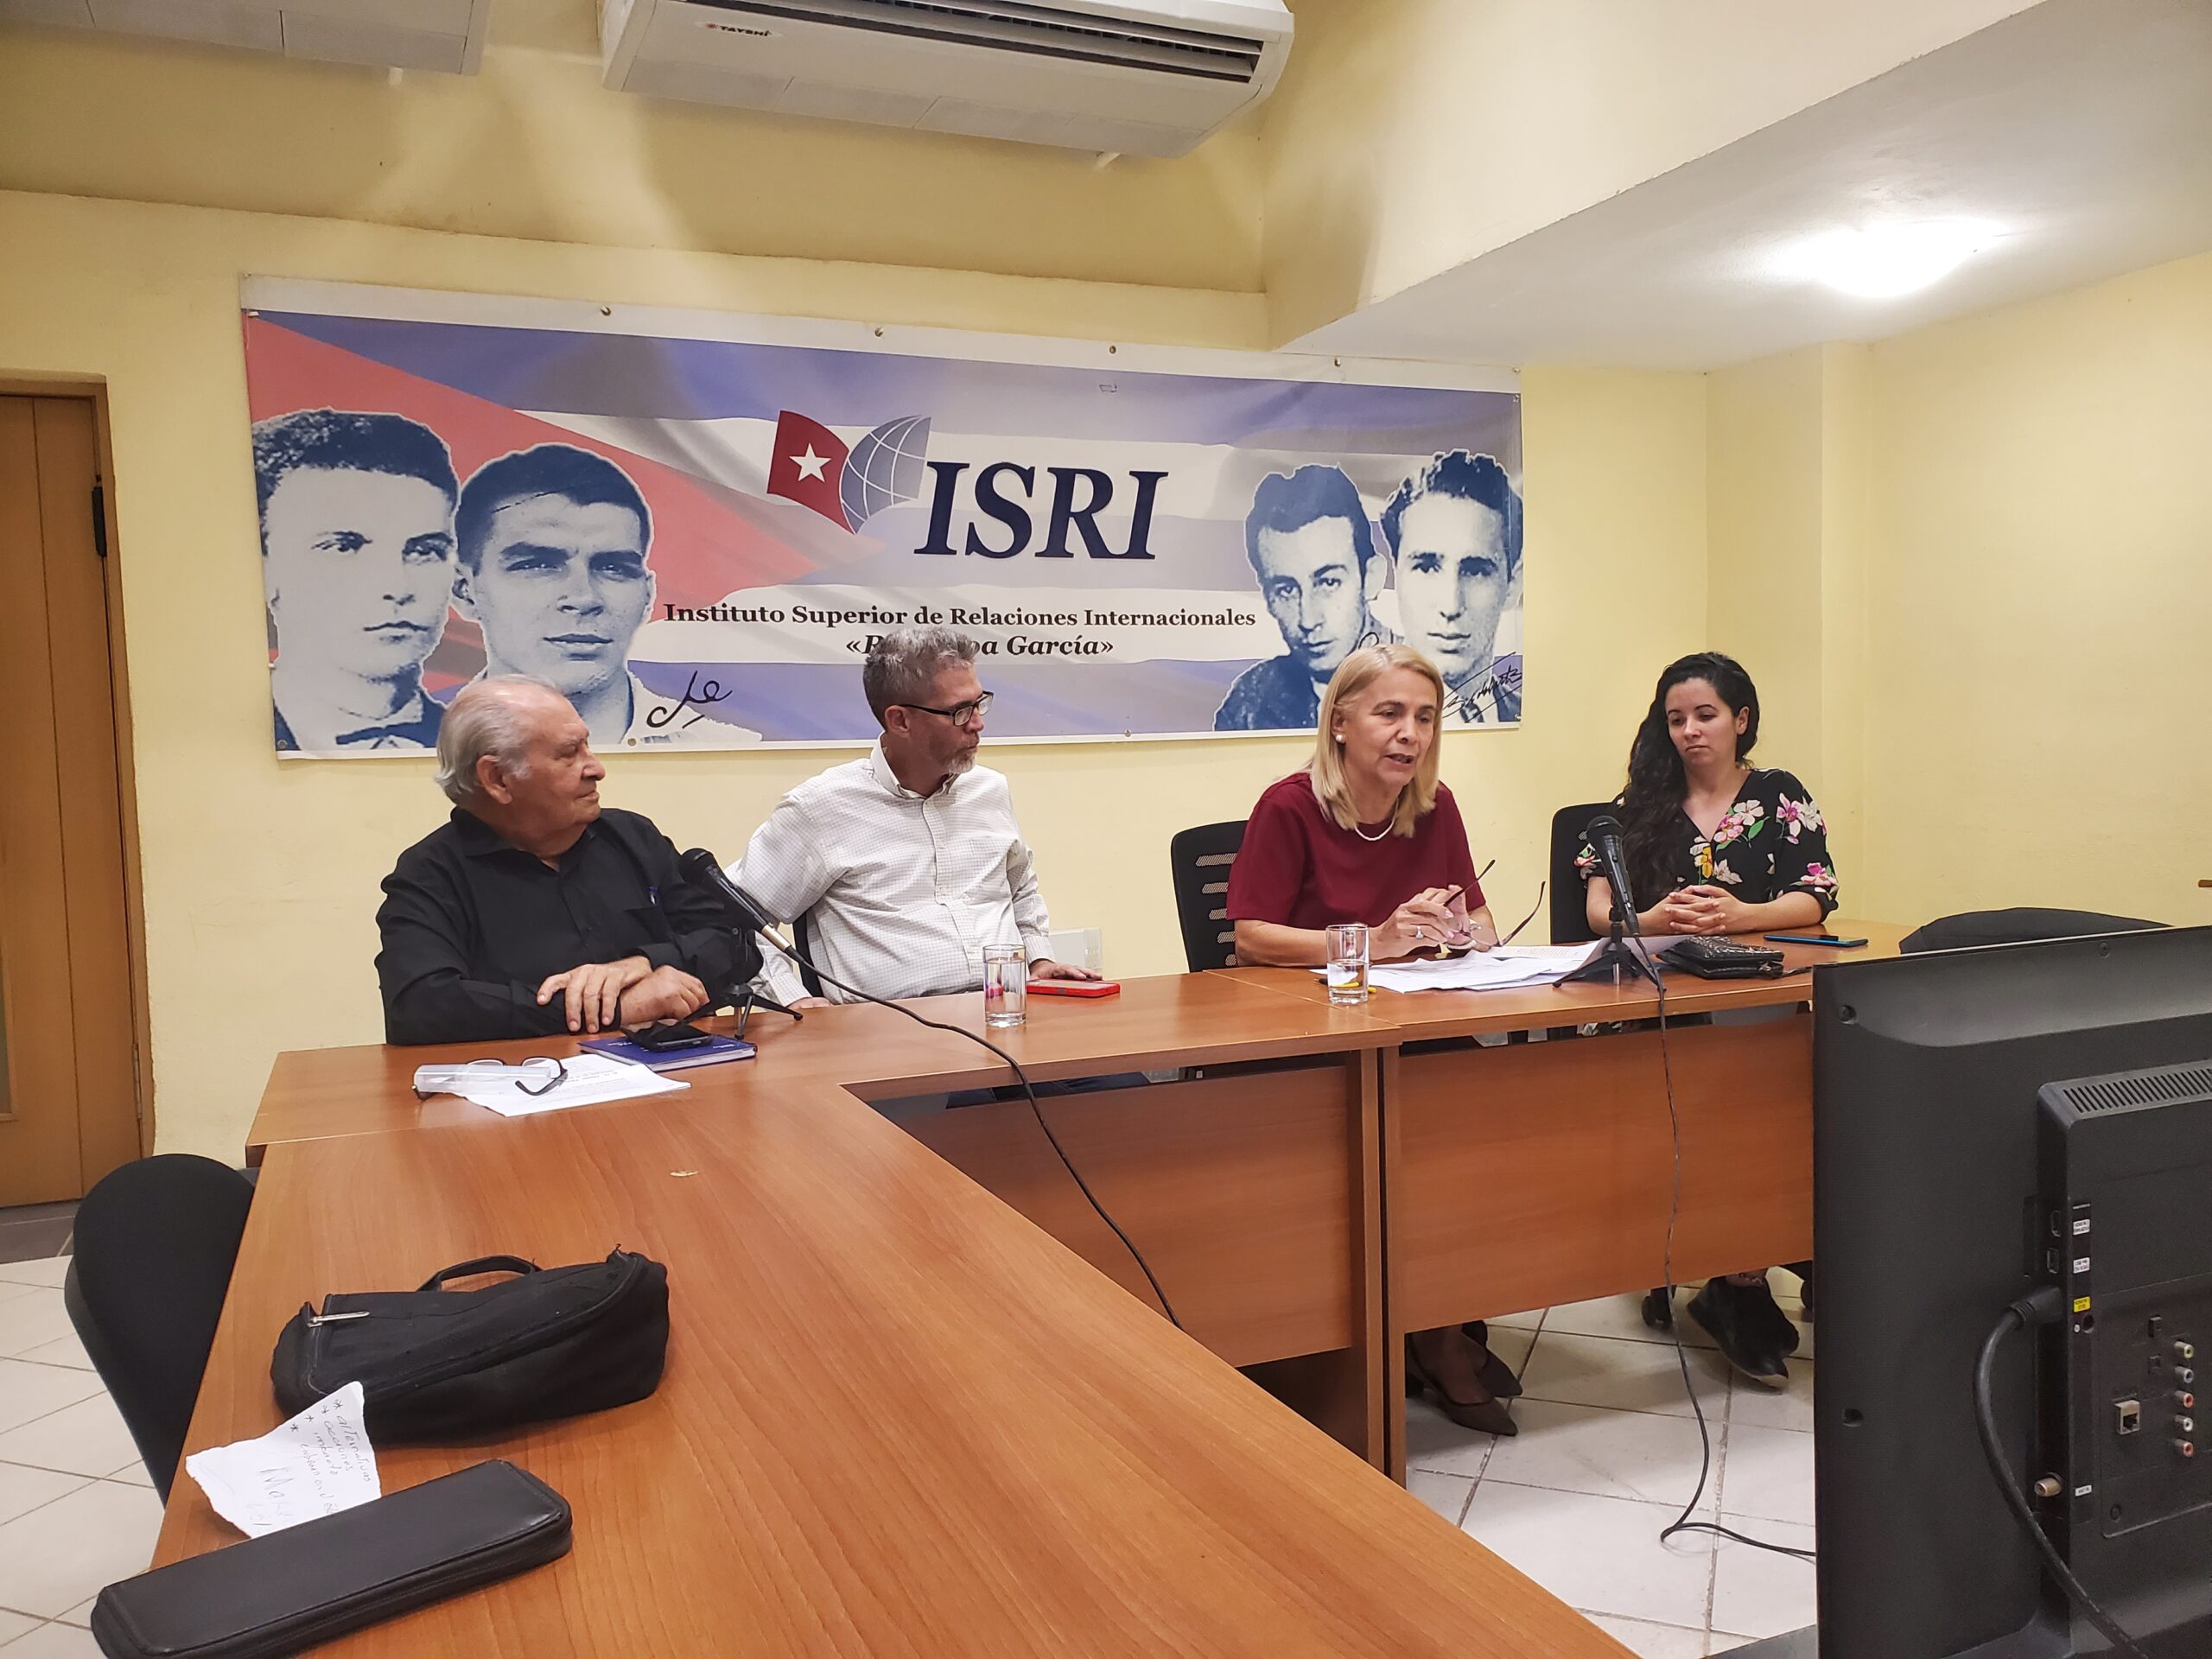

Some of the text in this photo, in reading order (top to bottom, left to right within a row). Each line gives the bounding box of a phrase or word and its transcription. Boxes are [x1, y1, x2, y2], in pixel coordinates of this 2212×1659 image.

[913, 461, 1169, 559] ISRI
[664, 603, 1256, 628] Instituto Superior de Relaciones Internacionales
